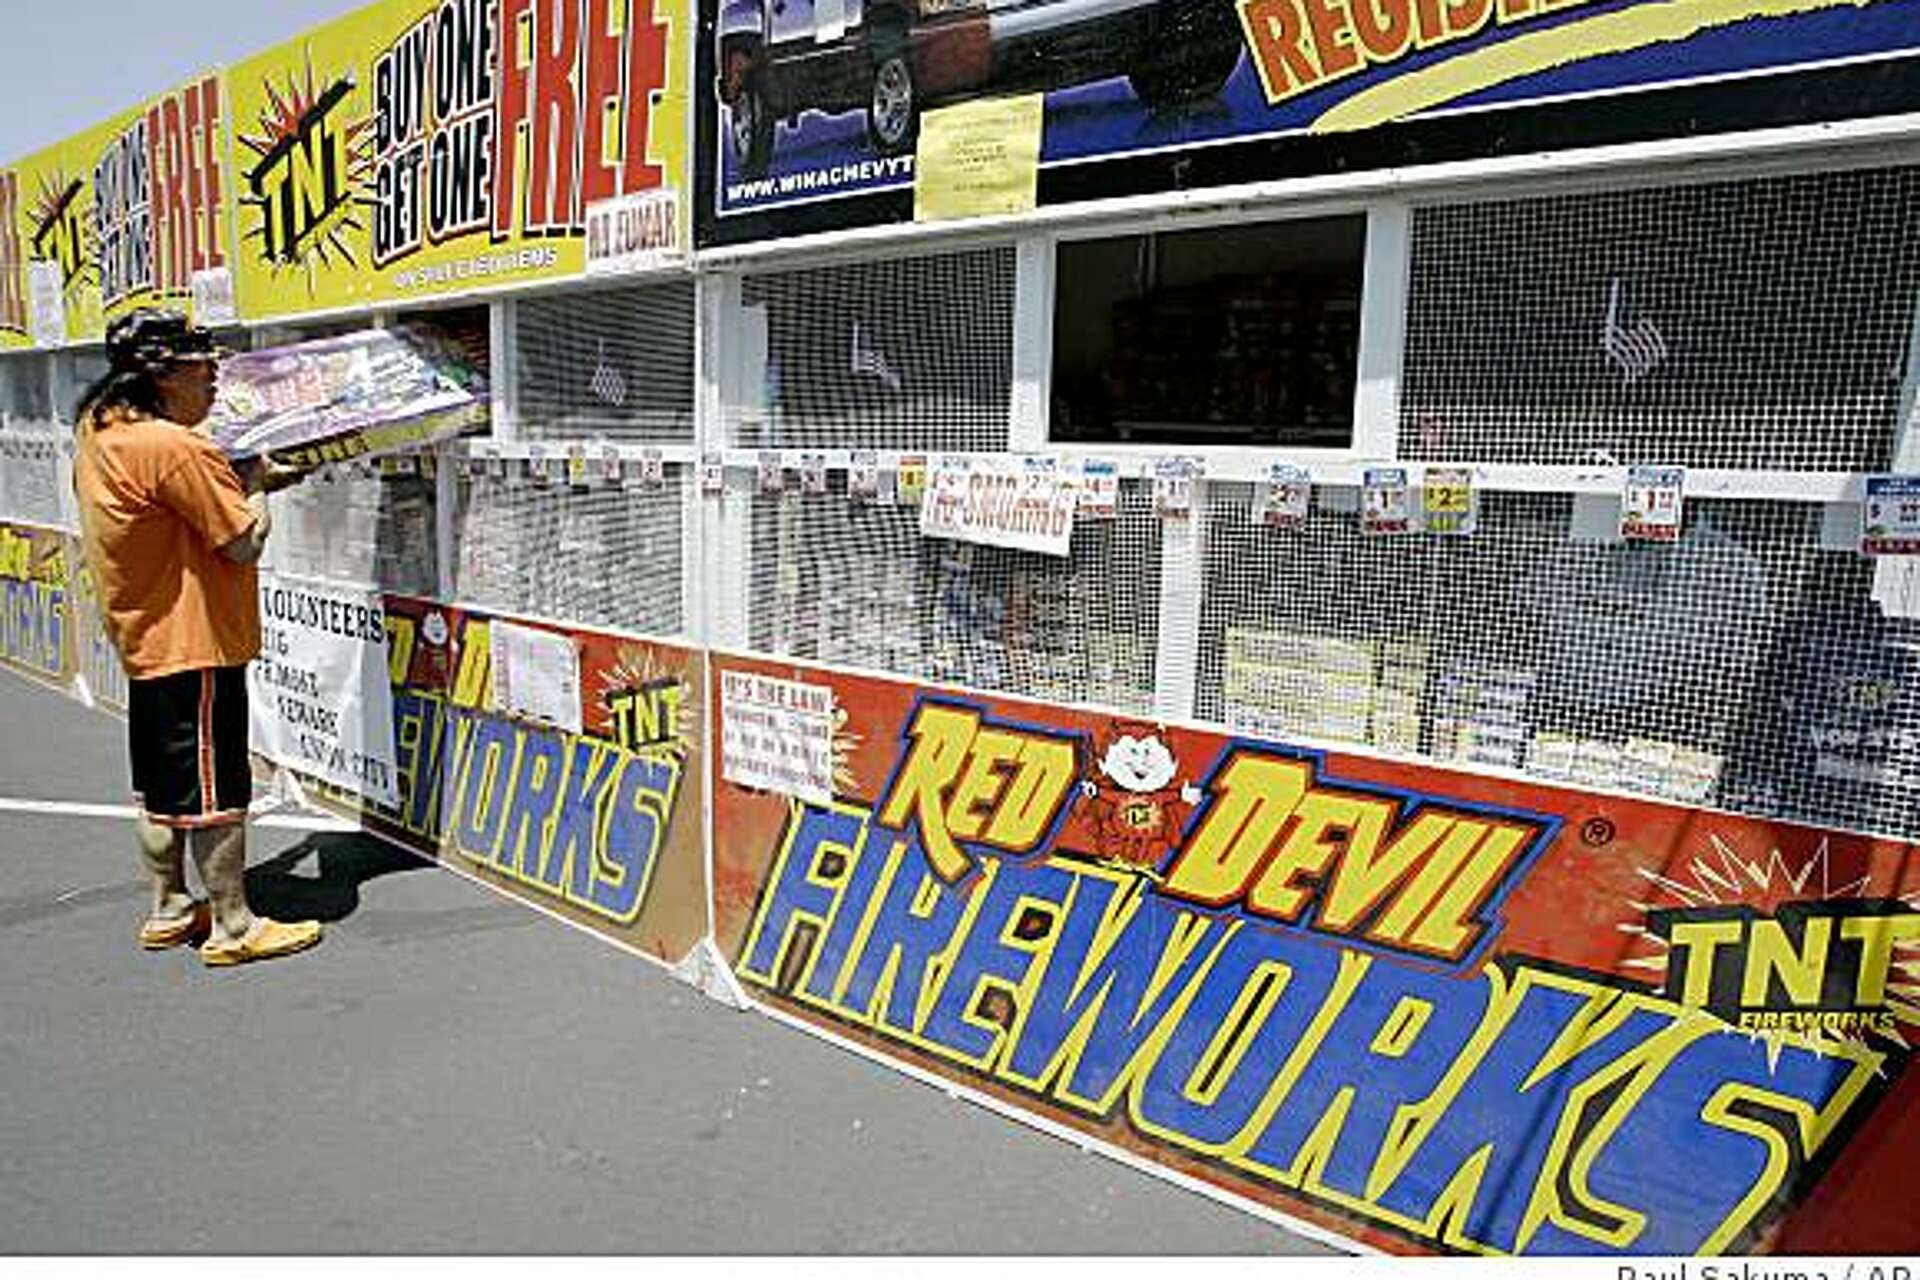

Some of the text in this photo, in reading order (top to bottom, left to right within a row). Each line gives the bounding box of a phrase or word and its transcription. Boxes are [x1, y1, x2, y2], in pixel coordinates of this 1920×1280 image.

[374, 0, 493, 151] BUY ONE
[490, 0, 672, 236] FREE
[147, 77, 223, 292] FREE
[261, 112, 348, 254] TNT
[374, 116, 493, 260] GET ONE
[615, 201, 677, 253] FUMAR
[262, 587, 385, 644] VOLUNTEERS
[612, 682, 682, 753] TNT
[879, 703, 1078, 880] RED
[1166, 753, 1531, 955] DEVIL
[735, 798, 1888, 1256] FIREWORKS
[1671, 912, 1920, 1008] TNT
[1739, 1011, 1895, 1033] FIREWORKS
